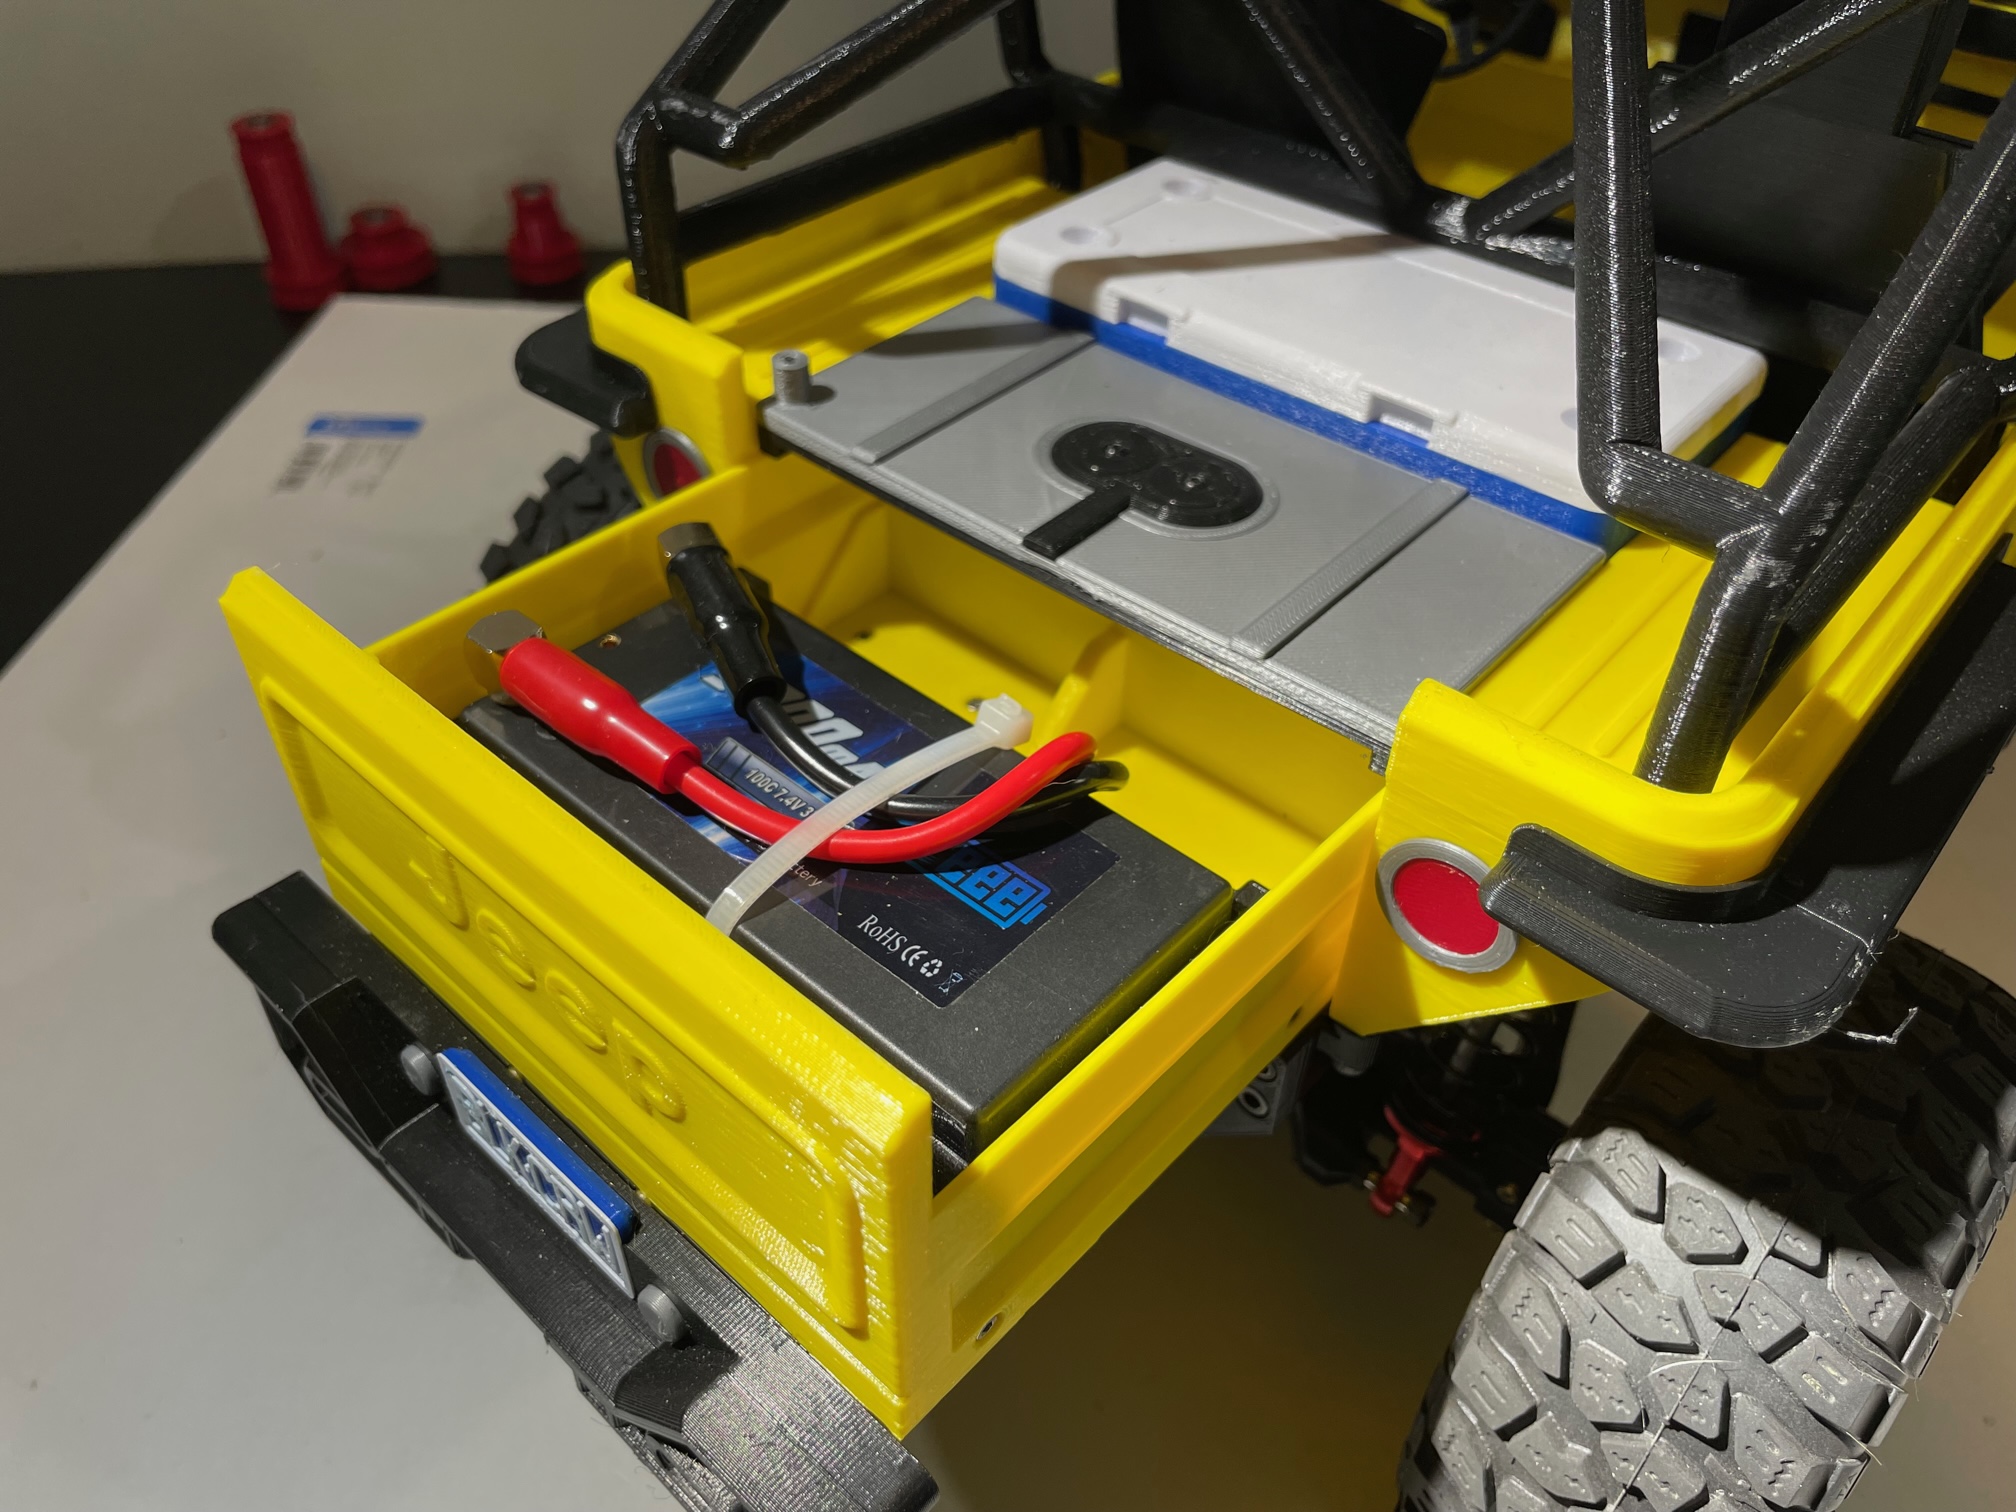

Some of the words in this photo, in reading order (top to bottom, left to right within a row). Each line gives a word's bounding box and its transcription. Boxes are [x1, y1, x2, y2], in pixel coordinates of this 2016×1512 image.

[745, 768, 778, 793] 100C
[771, 788, 807, 812] 7.4V
[857, 914, 907, 953] RoHS
